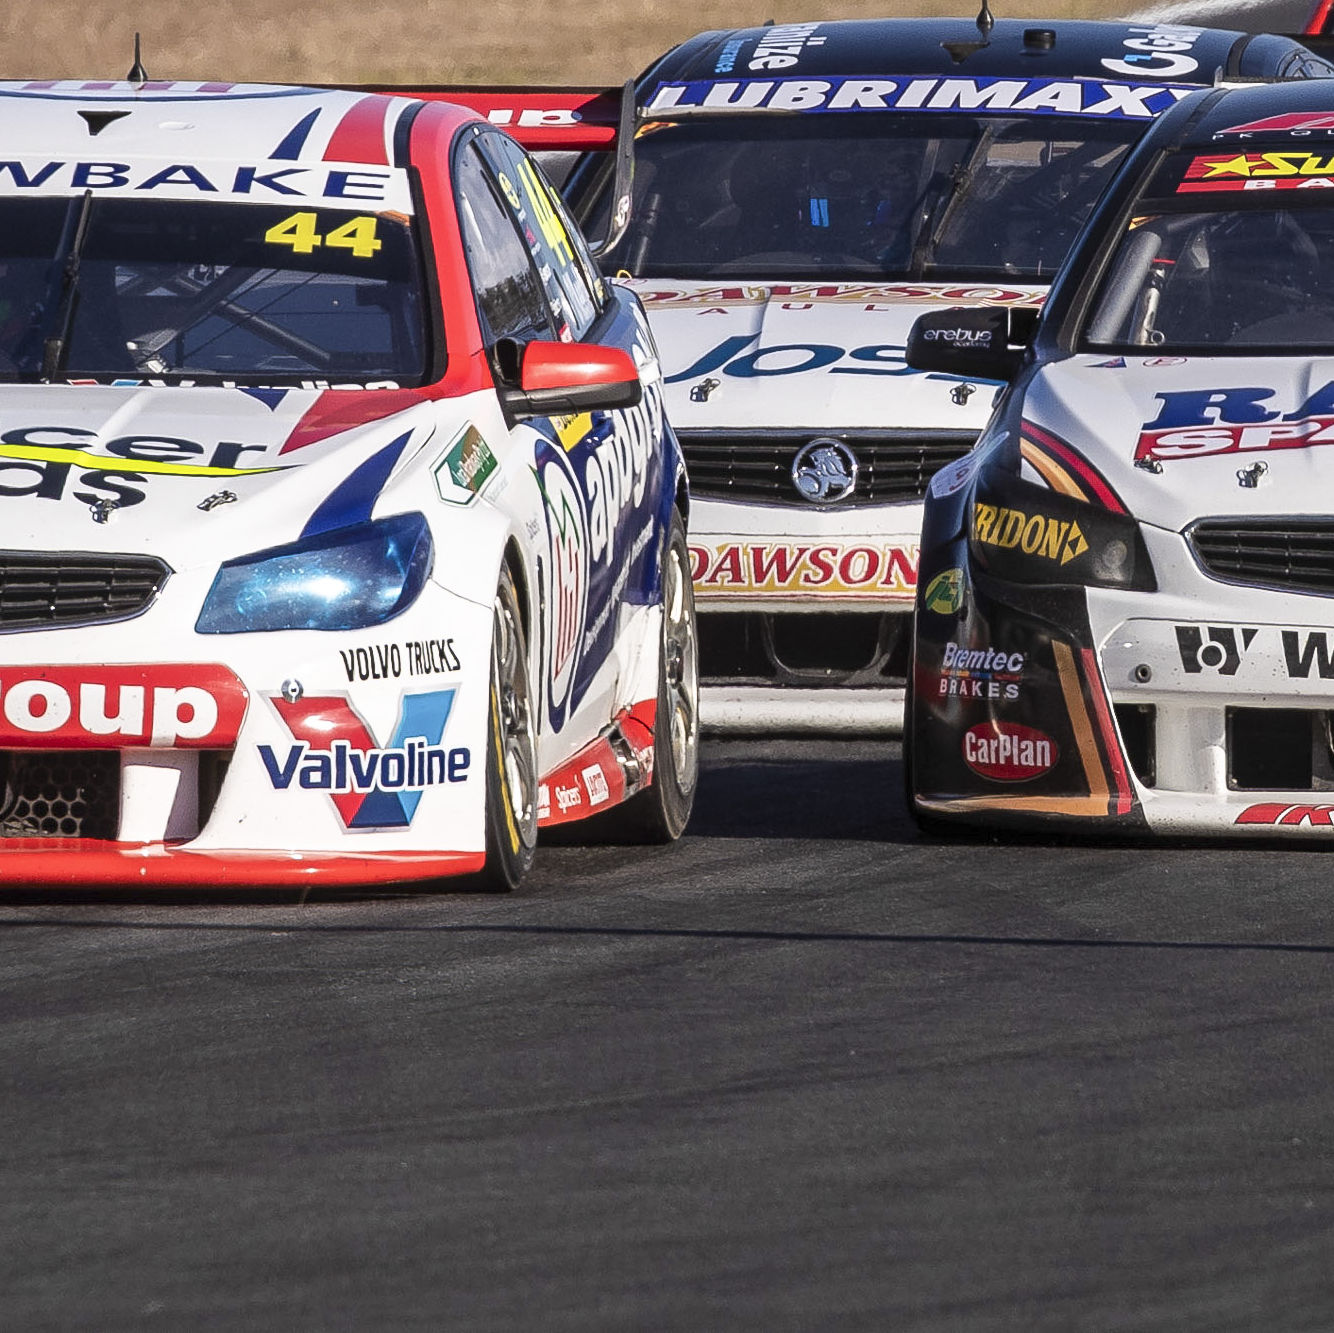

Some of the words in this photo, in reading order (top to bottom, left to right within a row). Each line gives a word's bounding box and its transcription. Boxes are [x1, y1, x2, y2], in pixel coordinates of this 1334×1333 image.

[265, 211, 381, 257] 44
[644, 283, 1047, 305] DAWSO
[340, 643, 401, 681] VOLVO
[406, 638, 460, 677] TRUCKS
[943, 642, 1025, 672] Bremtec
[939, 677, 1019, 700] BRAKES
[258, 738, 469, 791] Valvoline
[966, 731, 1051, 767] CarPlan
